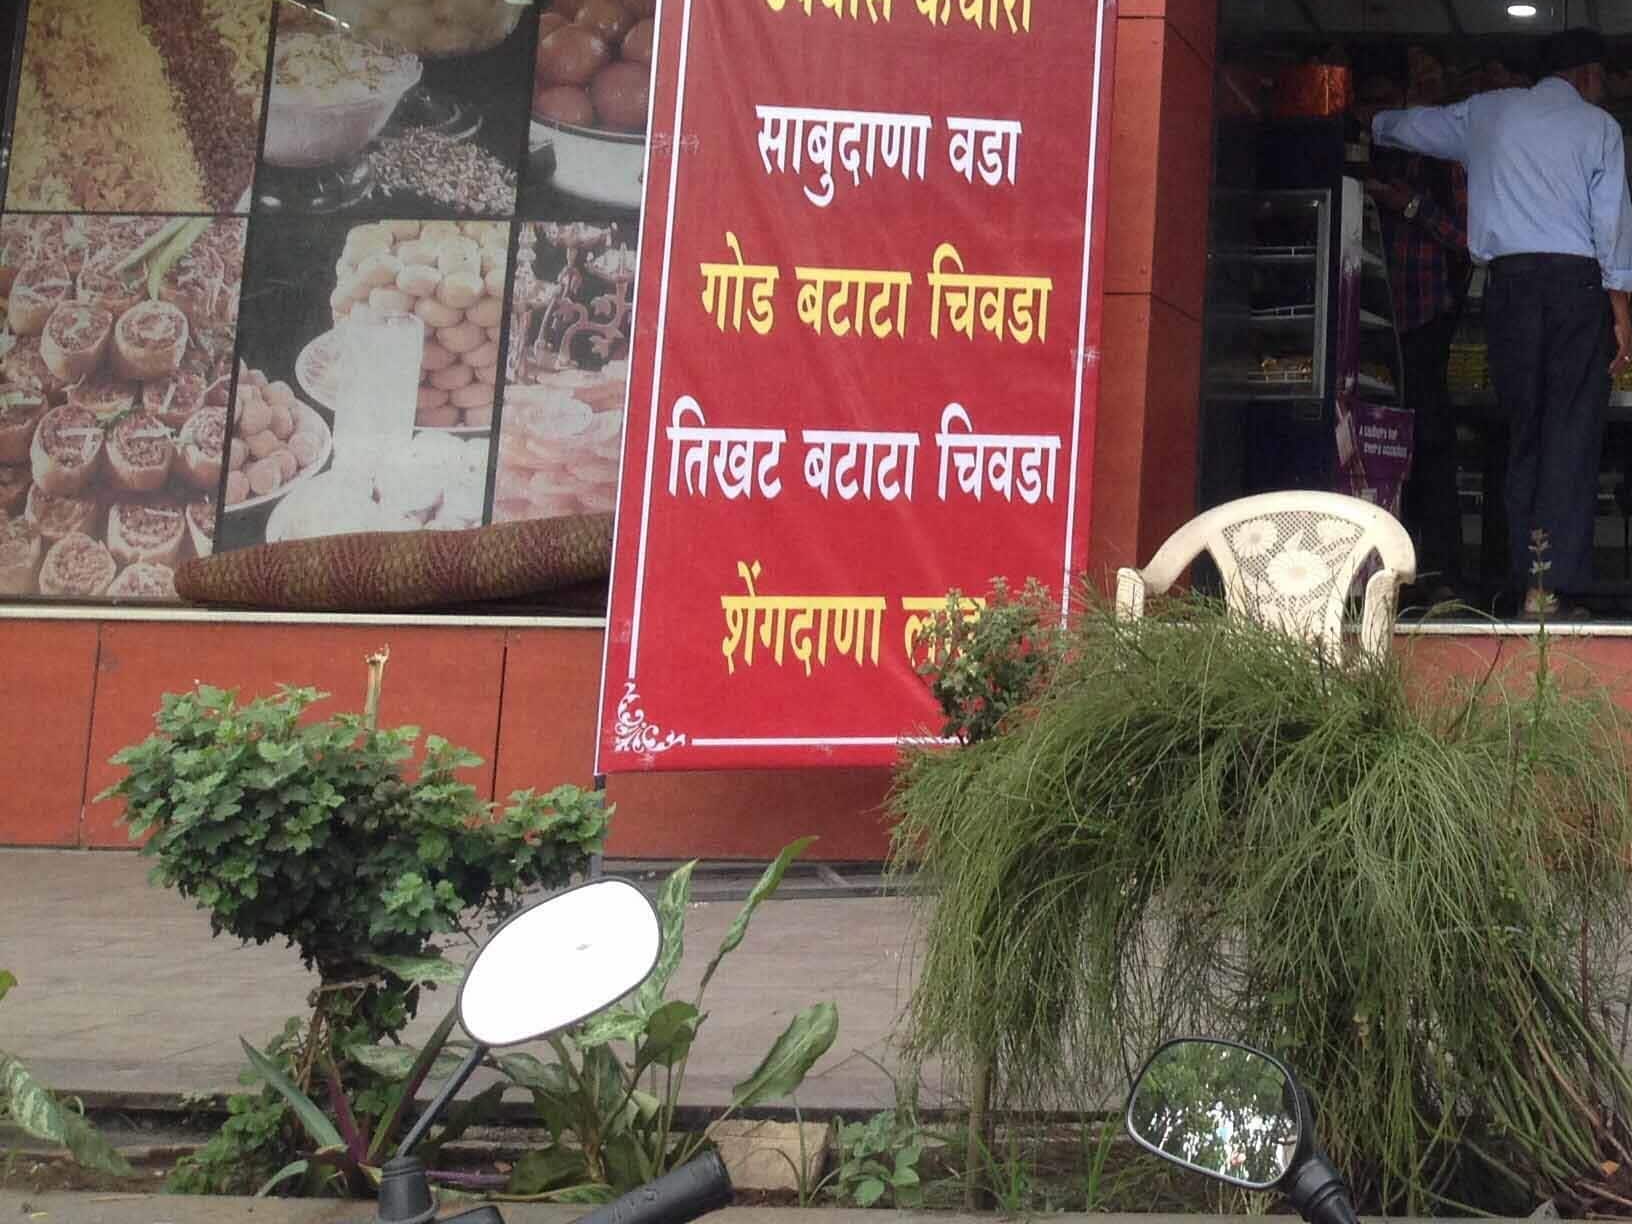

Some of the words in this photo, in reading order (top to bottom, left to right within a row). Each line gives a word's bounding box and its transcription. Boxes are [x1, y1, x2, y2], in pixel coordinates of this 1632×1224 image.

[755, 104, 932, 207] साबुदाणा
[946, 116, 1023, 186] वडा
[700, 231, 779, 335] गोड
[795, 265, 912, 339] बटाटा
[927, 242, 1053, 345] चिवडा
[665, 395, 787, 499] तिखट
[801, 428, 920, 502] बटाटा
[934, 402, 1062, 504] चिवडा
[720, 561, 886, 675] शेंगदाणा
